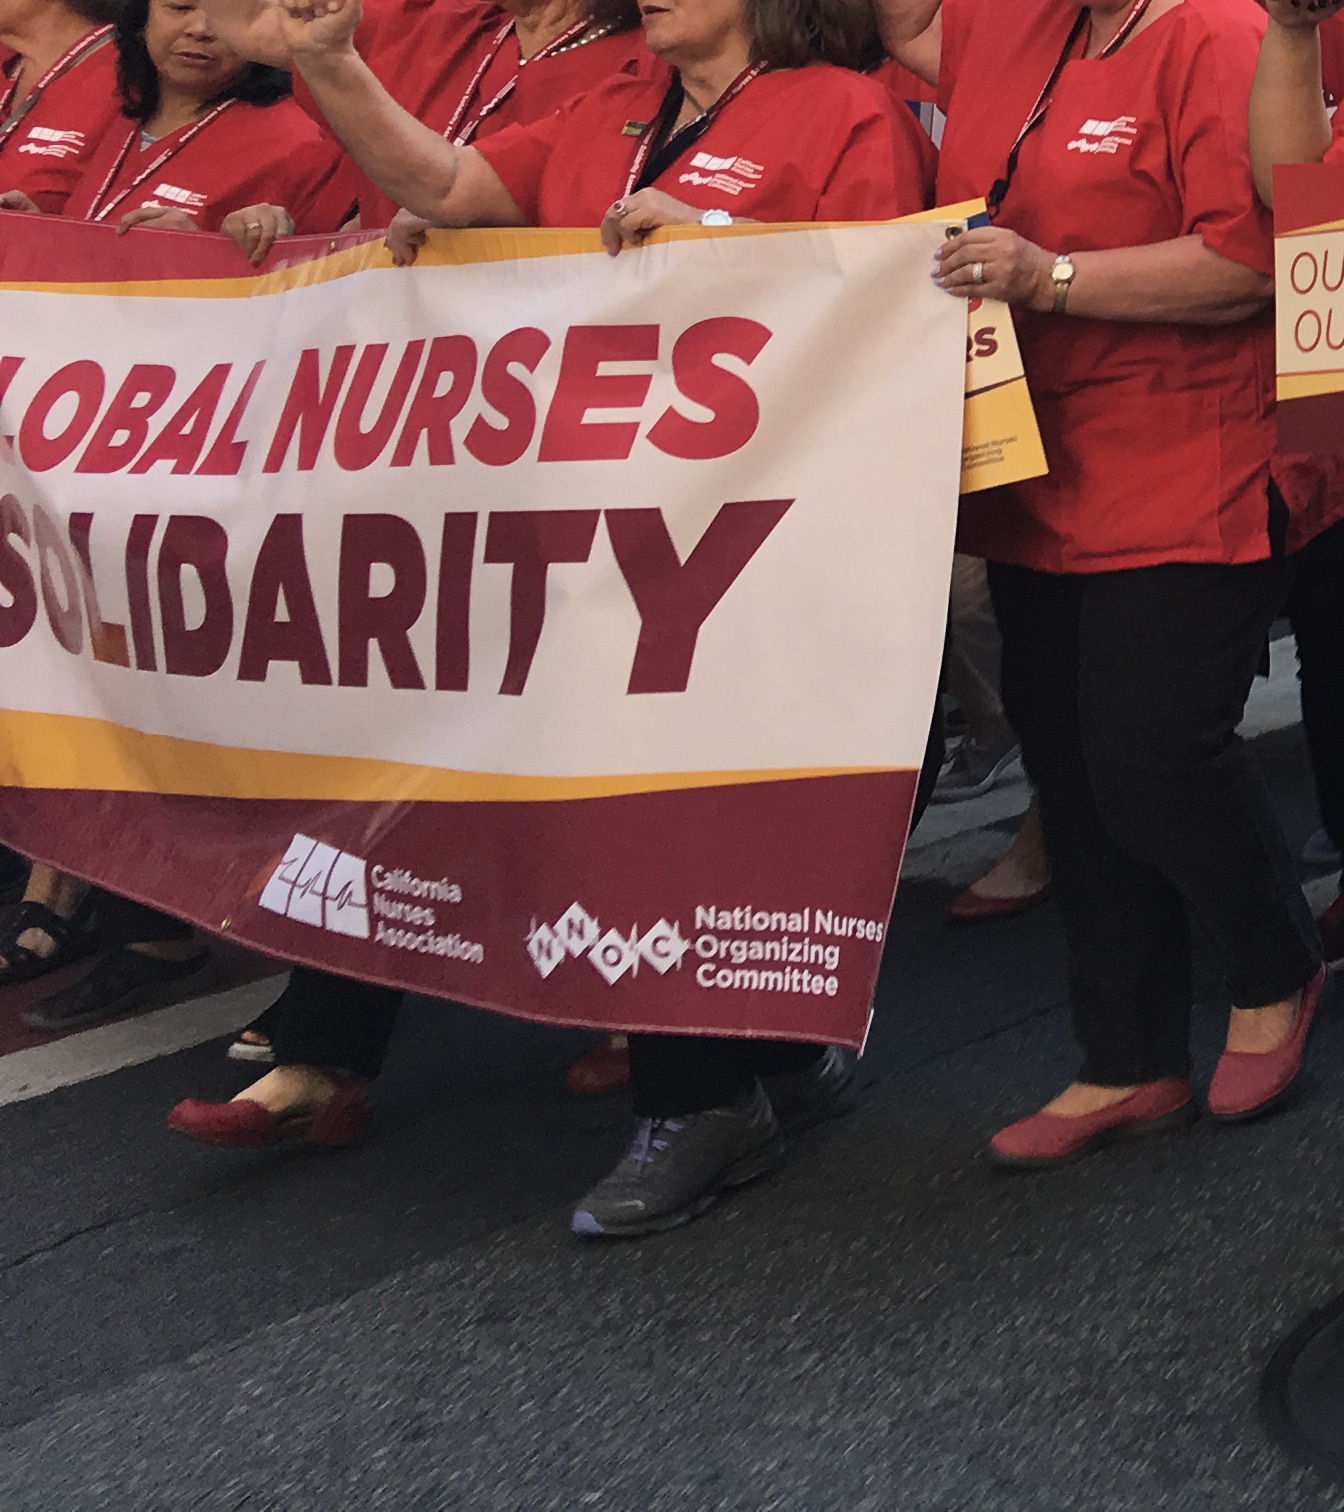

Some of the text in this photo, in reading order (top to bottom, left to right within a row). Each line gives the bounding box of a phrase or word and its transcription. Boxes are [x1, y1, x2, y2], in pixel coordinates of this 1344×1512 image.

[263, 315, 774, 475] NURSES
[0, 498, 797, 697] SOLIDARITY
[371, 864, 464, 904] California
[373, 892, 438, 928] Nurses
[694, 905, 886, 945] National Nurses
[373, 920, 486, 965] Association
[694, 937, 841, 970] Organizing
[694, 962, 840, 998] Committee
